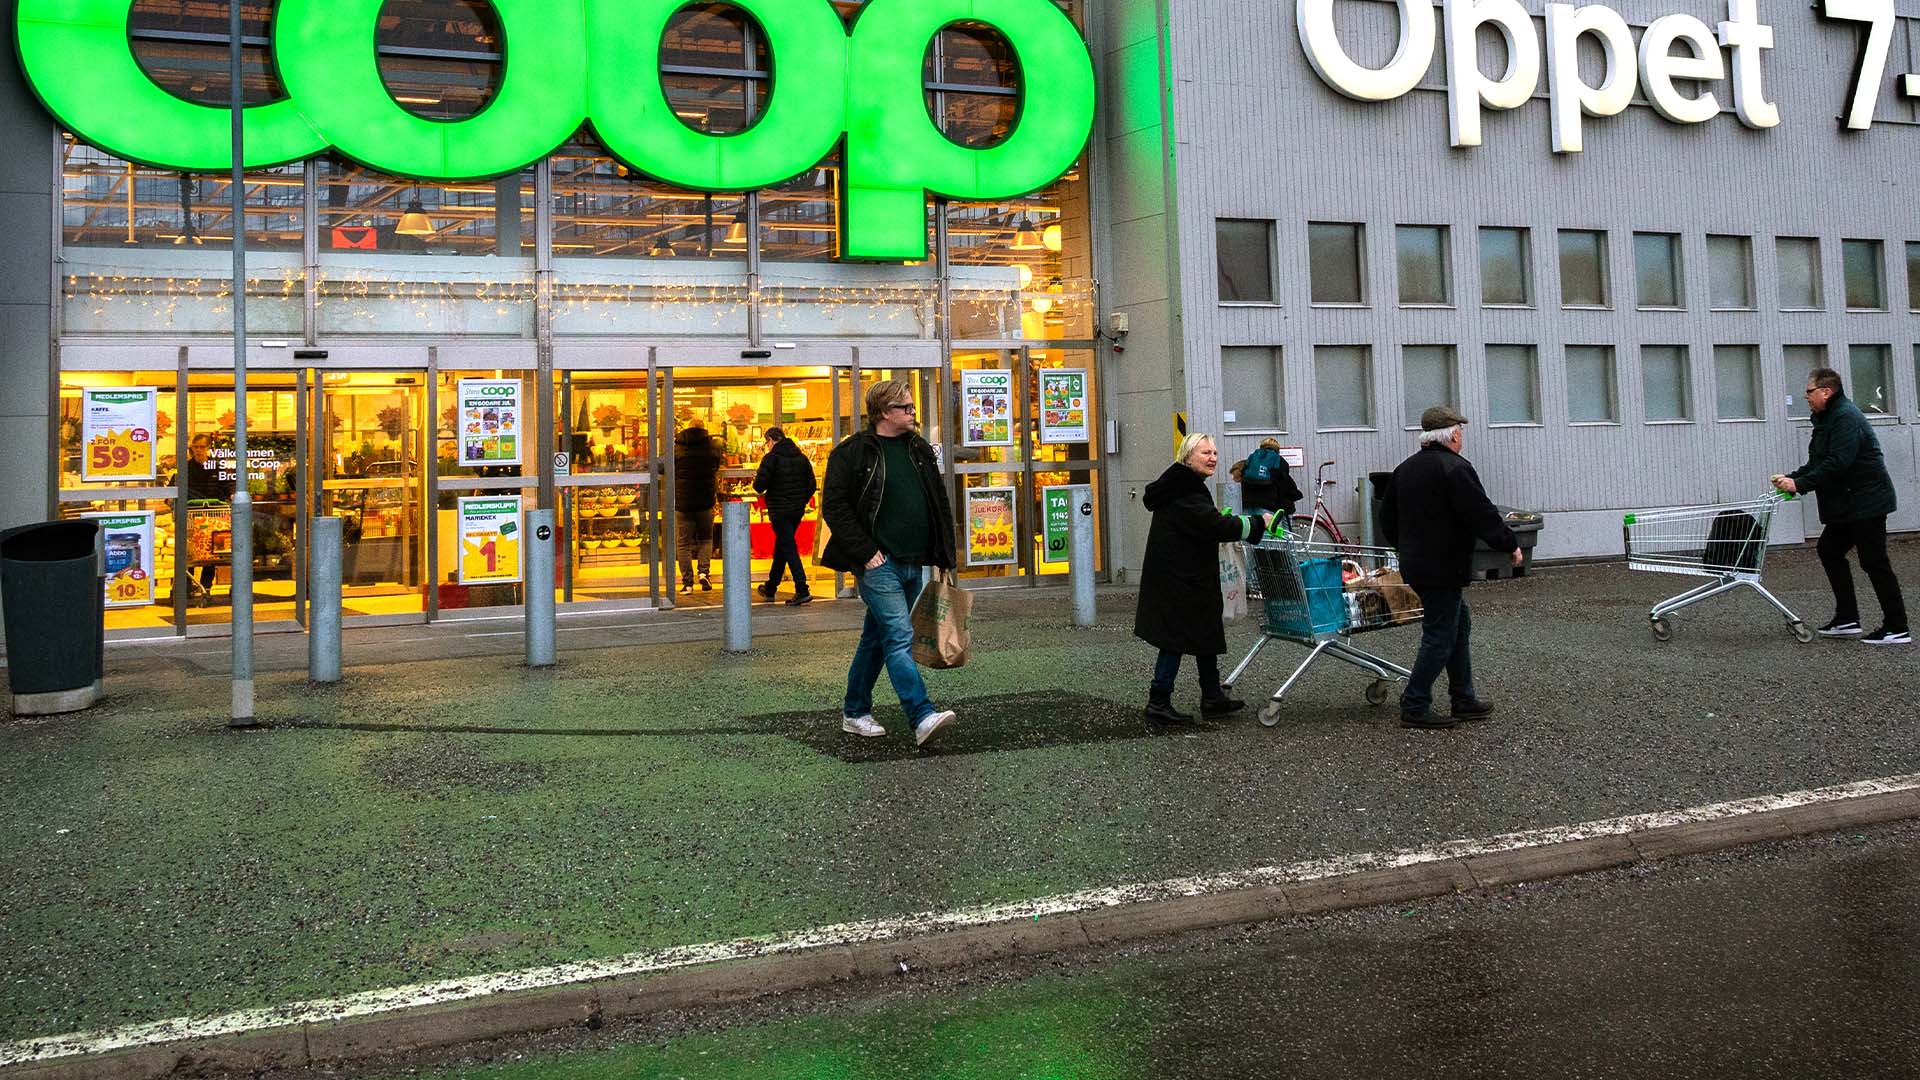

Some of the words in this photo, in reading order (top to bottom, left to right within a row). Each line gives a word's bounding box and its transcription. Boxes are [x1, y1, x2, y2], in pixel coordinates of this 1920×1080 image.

[14, 0, 1097, 262] coop
[980, 376, 1007, 386] coop
[481, 386, 515, 397] coop
[93, 446, 145, 469] 59:-
[203, 460, 216, 470] till
[251, 460, 281, 471] Coop
[218, 471, 265, 481] Broma
[1050, 497, 1068, 508] TA
